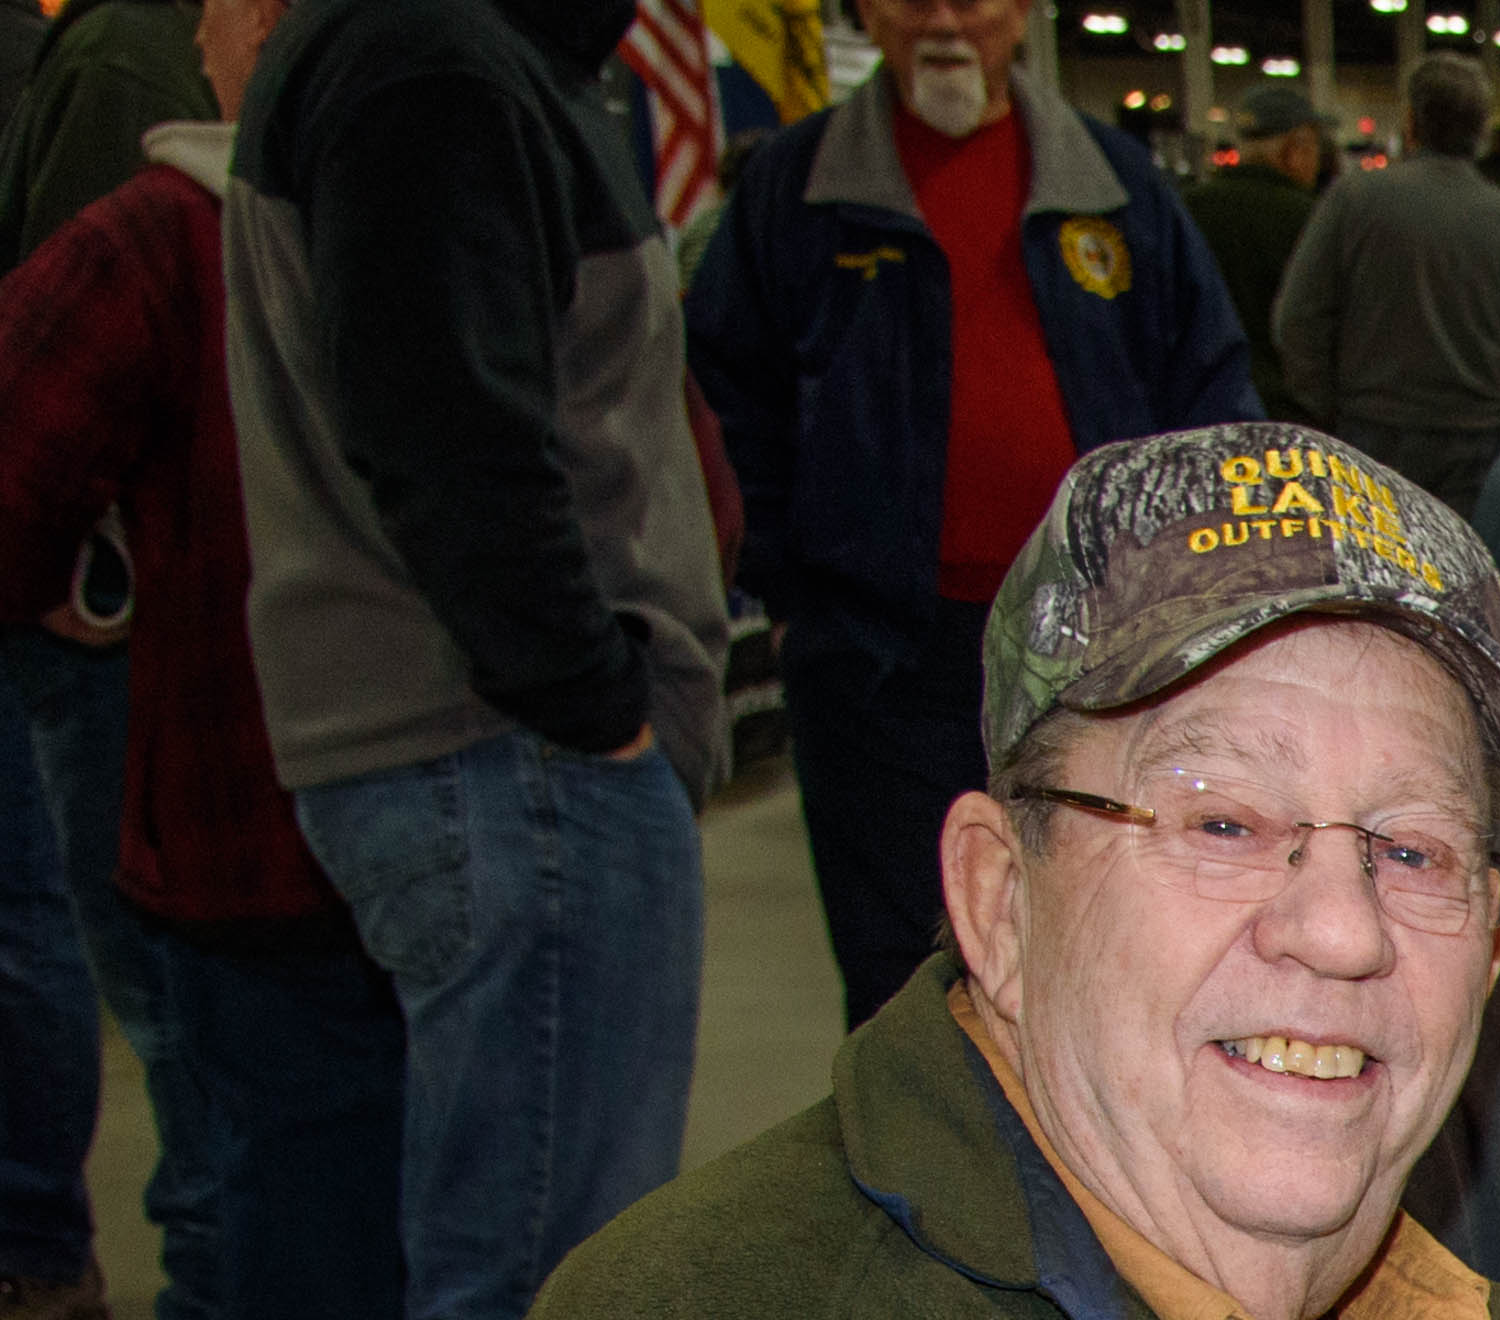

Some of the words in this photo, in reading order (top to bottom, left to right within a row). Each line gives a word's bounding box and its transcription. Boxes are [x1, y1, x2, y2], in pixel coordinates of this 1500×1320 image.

[1219, 447, 1399, 516] QUINN
[1230, 481, 1408, 545] LAKE
[1187, 516, 1445, 592] OUTFITTERS
